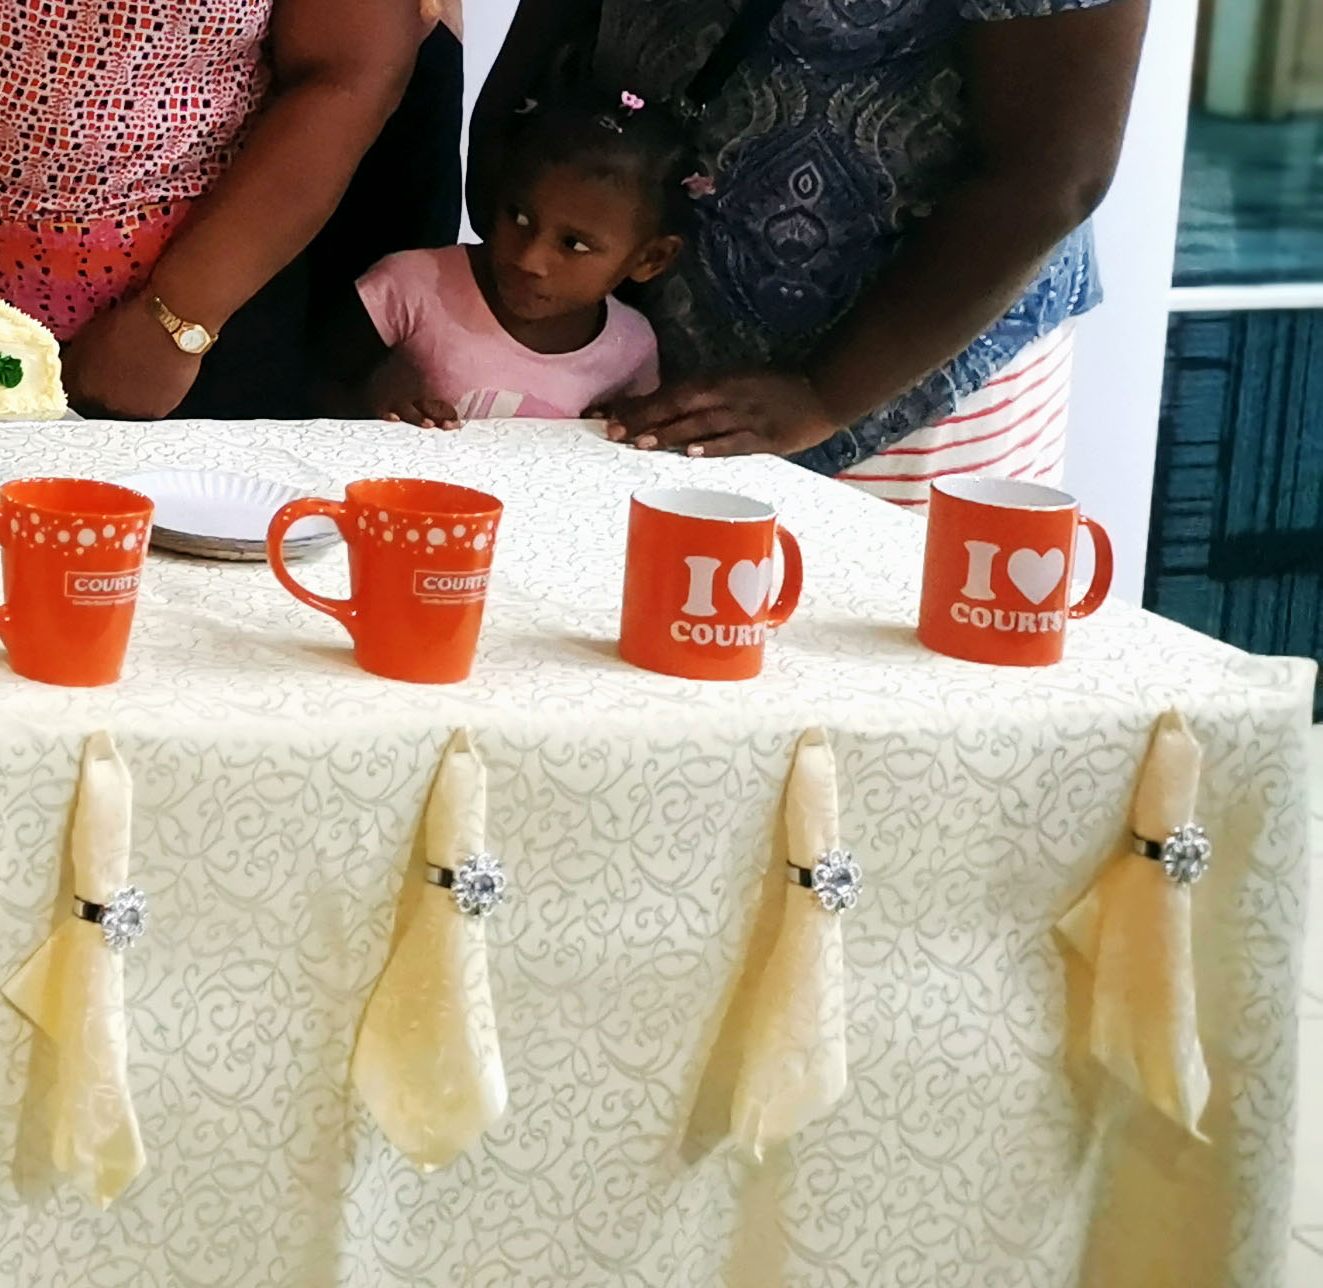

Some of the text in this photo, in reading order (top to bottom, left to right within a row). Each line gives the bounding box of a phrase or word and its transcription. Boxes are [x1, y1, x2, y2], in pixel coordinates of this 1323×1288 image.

[681, 555, 720, 618] I
[963, 540, 1001, 601] I
[949, 602, 1065, 635] COURTS
